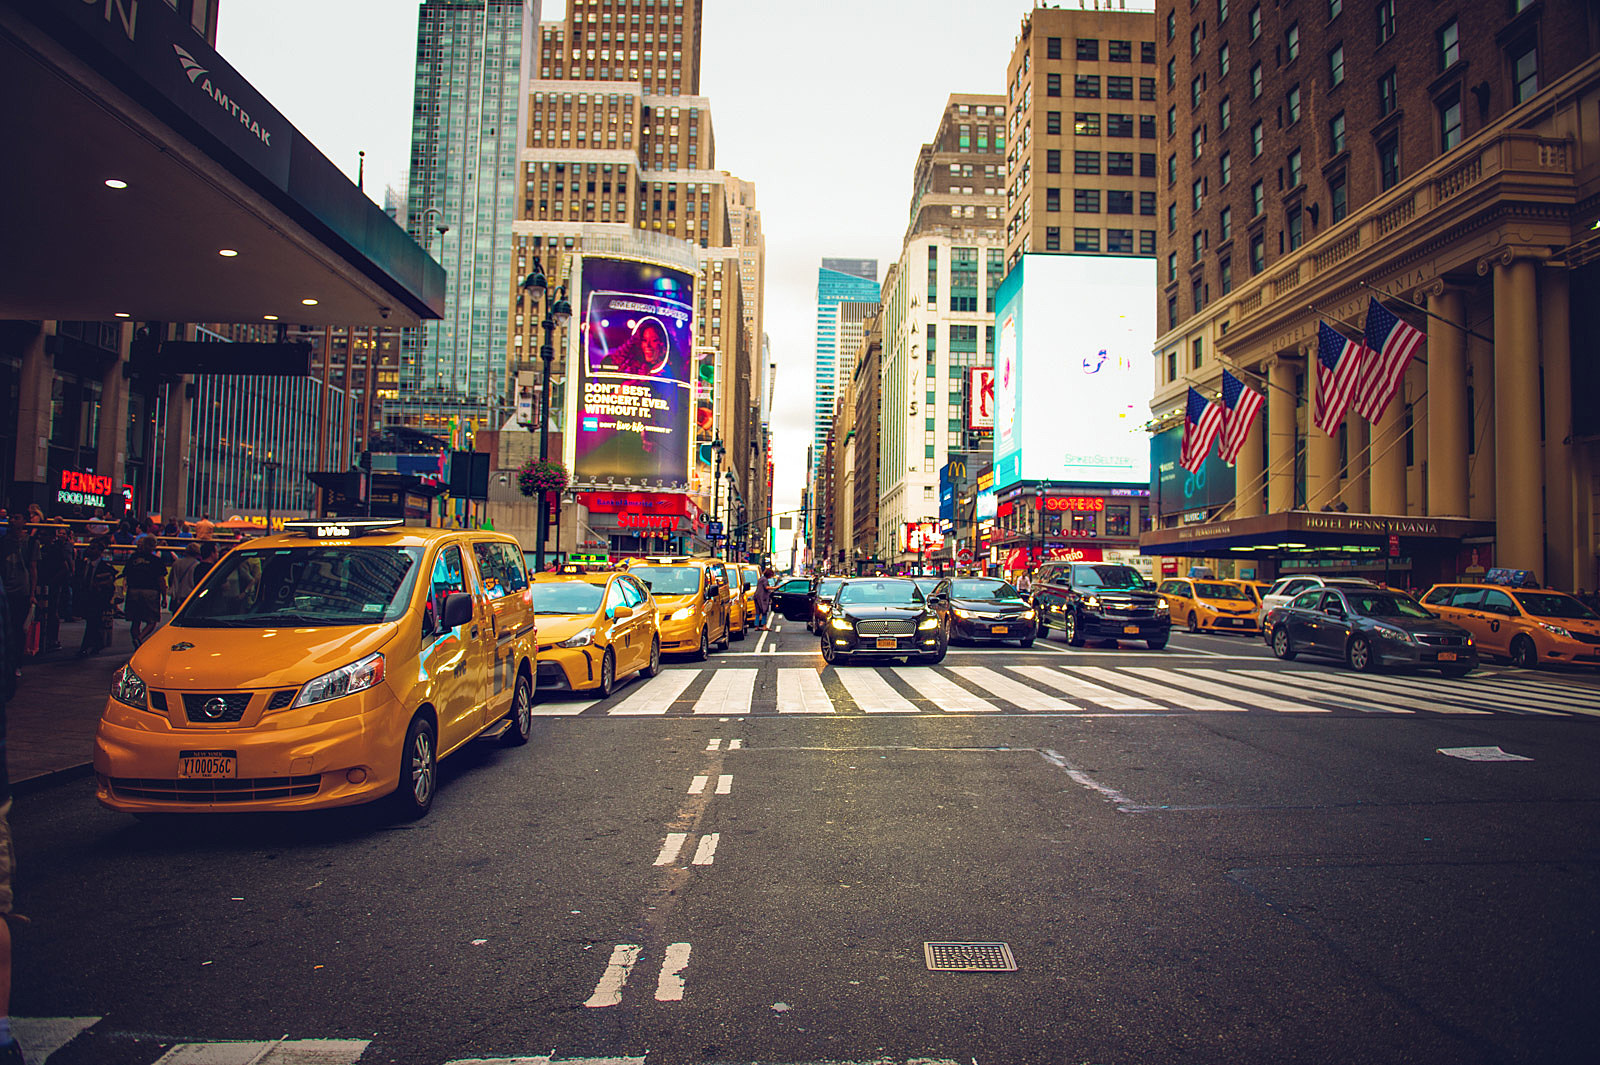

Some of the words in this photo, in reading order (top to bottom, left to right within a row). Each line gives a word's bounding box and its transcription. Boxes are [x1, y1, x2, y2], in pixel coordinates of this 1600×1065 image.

[201, 79, 271, 147] AMTRAK
[1272, 326, 1307, 348] HOTEL
[1313, 270, 1424, 331] PNNSYLVANIA
[584, 382, 620, 395] DON'T
[622, 384, 652, 398] BEST.
[584, 393, 640, 407] CONCERT.
[641, 397, 670, 410] EVER.
[584, 403, 638, 417] WITHOUT
[638, 406, 652, 418] IT.
[61, 469, 113, 496] PENNSY
[58, 490, 83, 505] FOOD
[84, 494, 106, 508] HALL
[617, 511, 680, 531] Subway
[1306, 517, 1344, 529] HOTEL
[1349, 519, 1437, 533] PENNSYLVANIA
[184, 758, 231, 774] Y100056C
